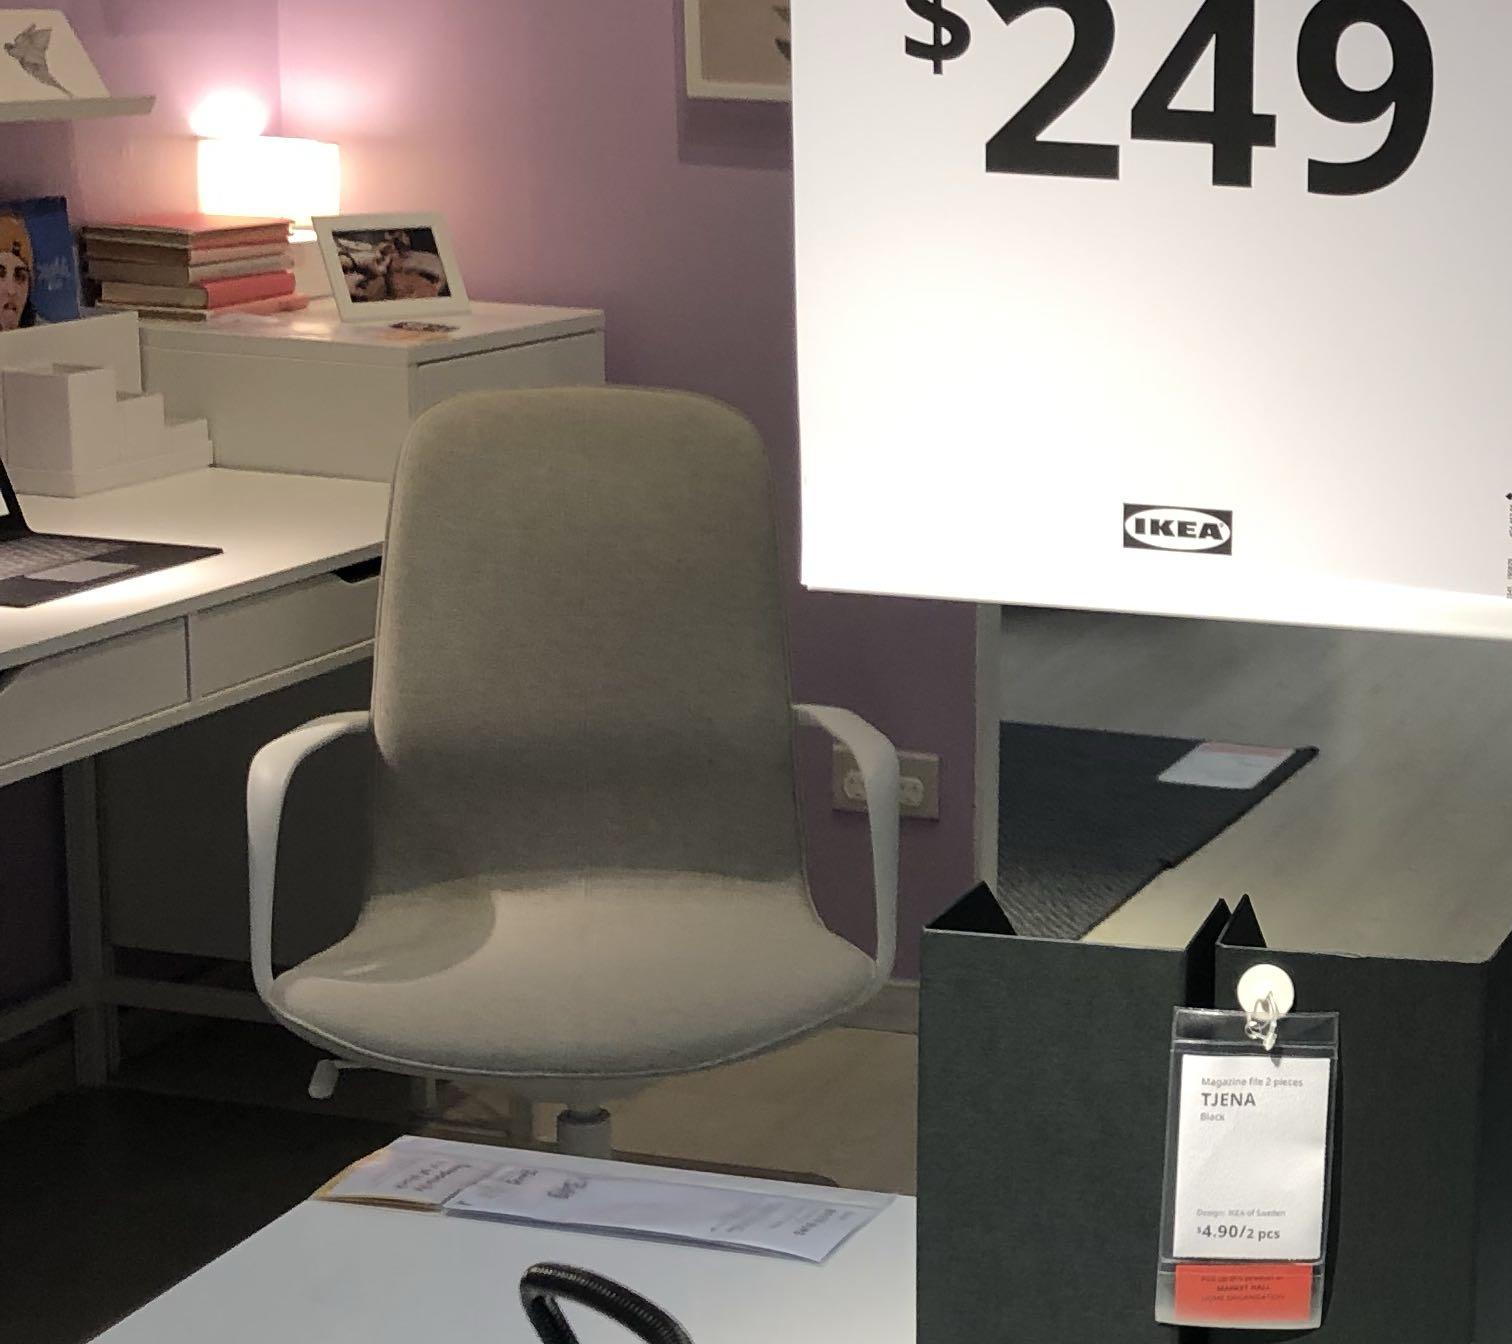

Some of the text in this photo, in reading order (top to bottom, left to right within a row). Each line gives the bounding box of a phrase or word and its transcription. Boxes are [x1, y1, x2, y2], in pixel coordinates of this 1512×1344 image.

[1133, 517, 1224, 541] IKEA
[1201, 1077, 1247, 1089] Magazine
[1265, 1077, 1272, 1087] 2
[1273, 1077, 1304, 1088] pieces
[1201, 1092, 1256, 1107] TJENA
[1200, 1112, 1225, 1122] Black
[1258, 1229, 1281, 1242] pcs
